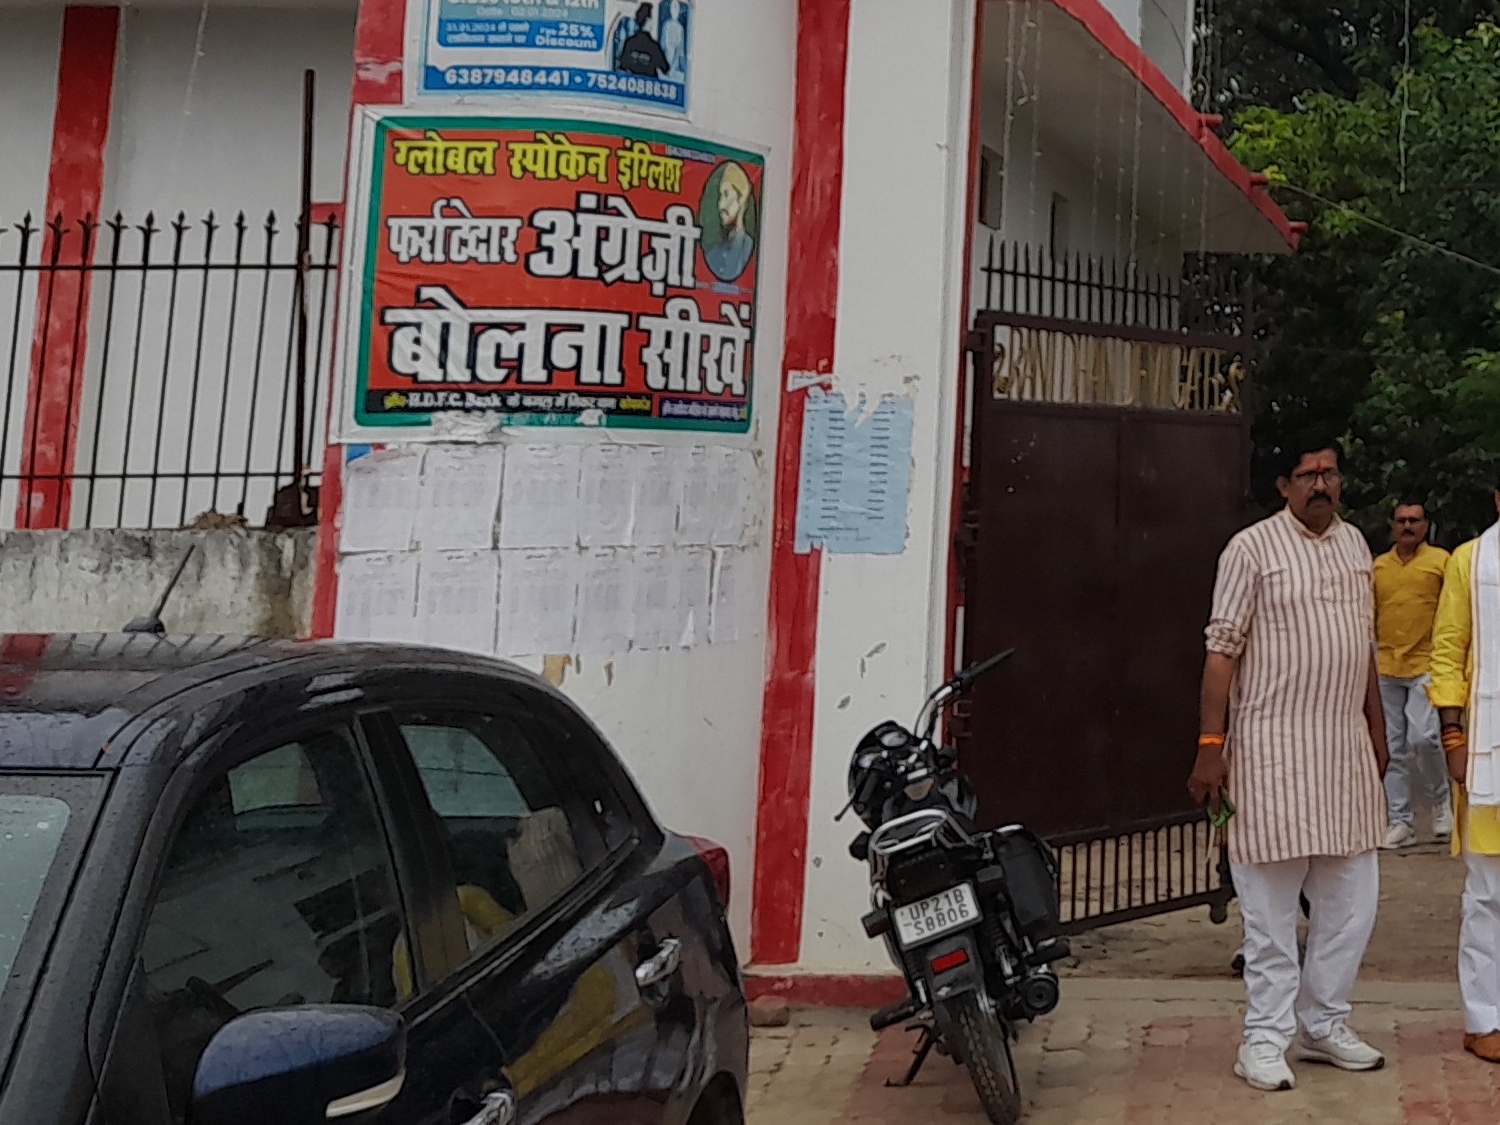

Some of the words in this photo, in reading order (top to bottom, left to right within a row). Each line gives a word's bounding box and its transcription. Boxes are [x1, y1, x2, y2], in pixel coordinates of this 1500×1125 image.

[535, 36, 598, 50] Discount
[558, 24, 595, 38] 25%
[393, 130, 500, 176] ग्लोबल
[507, 131, 611, 182] स्पोकेन
[616, 139, 684, 194] इंग्लिश
[381, 283, 631, 386] बोलना
[636, 296, 753, 396] सीखें
[908, 888, 965, 921] UP21B
